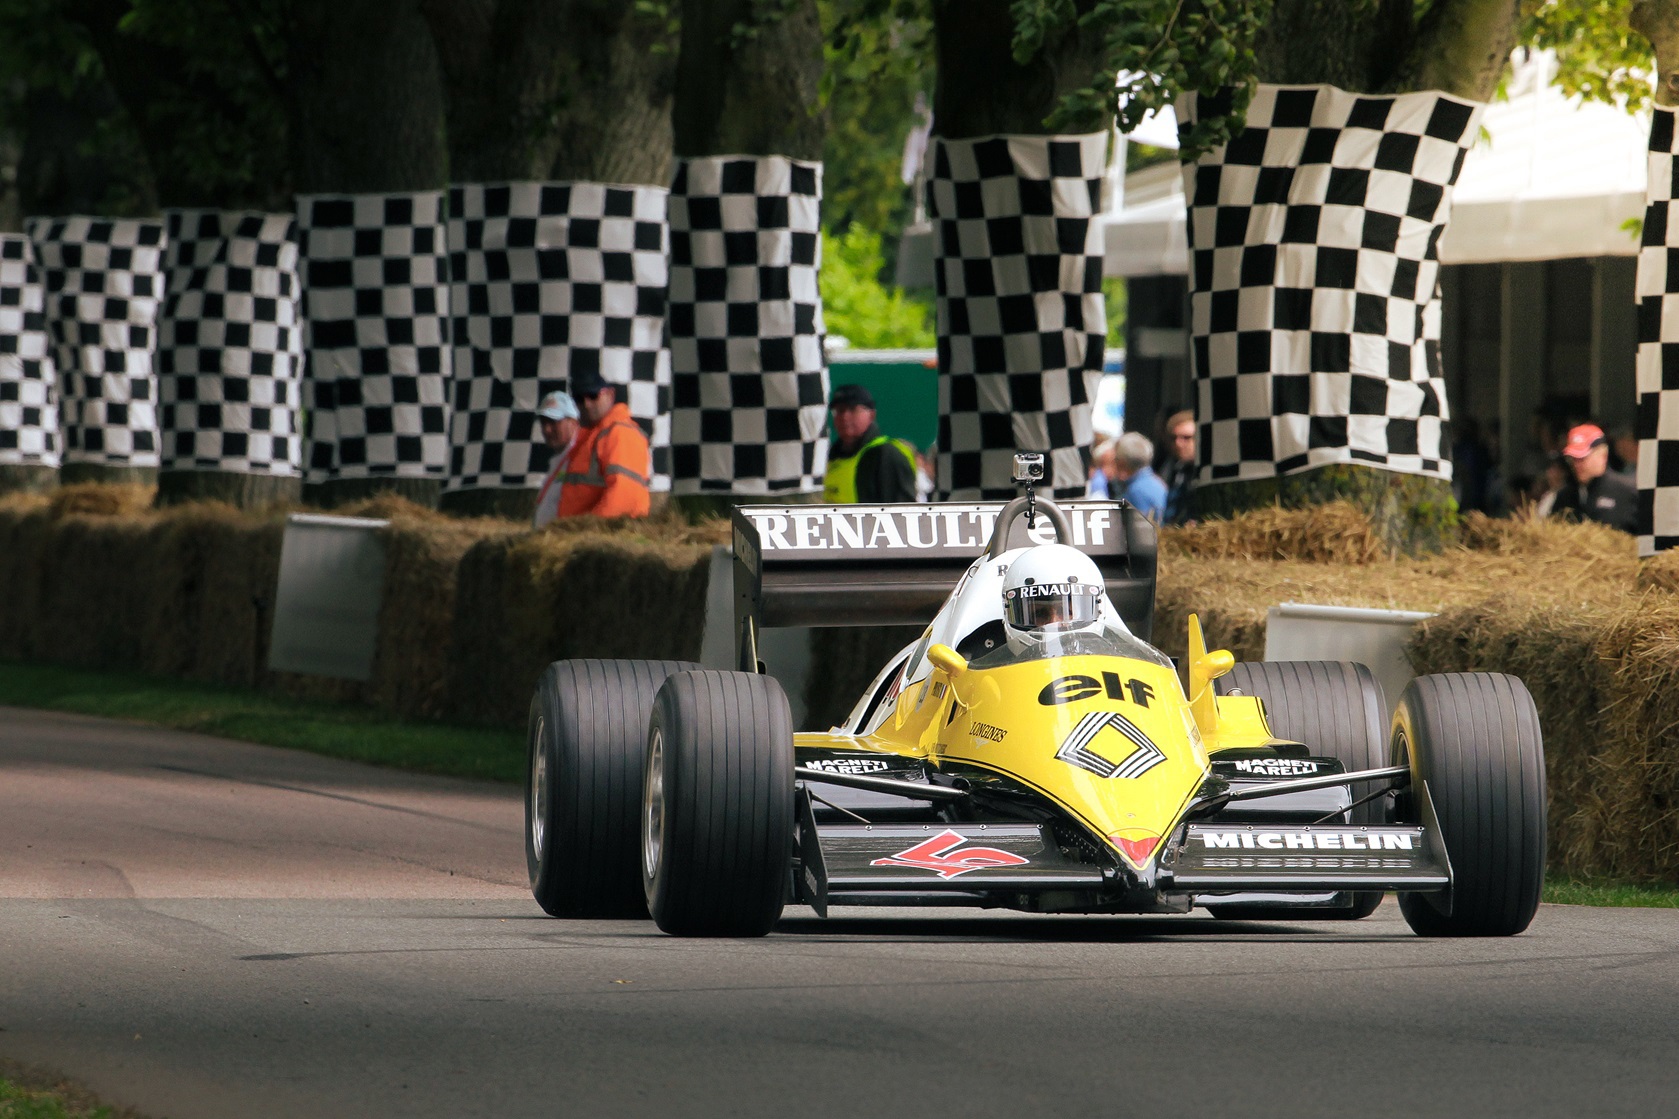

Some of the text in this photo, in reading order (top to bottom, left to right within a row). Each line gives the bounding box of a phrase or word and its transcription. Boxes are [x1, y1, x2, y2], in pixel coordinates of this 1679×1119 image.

[752, 510, 1111, 549] RENAULT elf
[1020, 585, 1085, 598] RENAULT
[1038, 671, 1156, 709] elf
[969, 721, 1008, 743] LONGINES
[805, 760, 888, 768] MAGNETI
[805, 764, 888, 774] MARELLI
[1235, 759, 1318, 767] MAGNETI
[1235, 764, 1318, 775] MARELLI
[1203, 833, 1413, 849] MICHELIN
